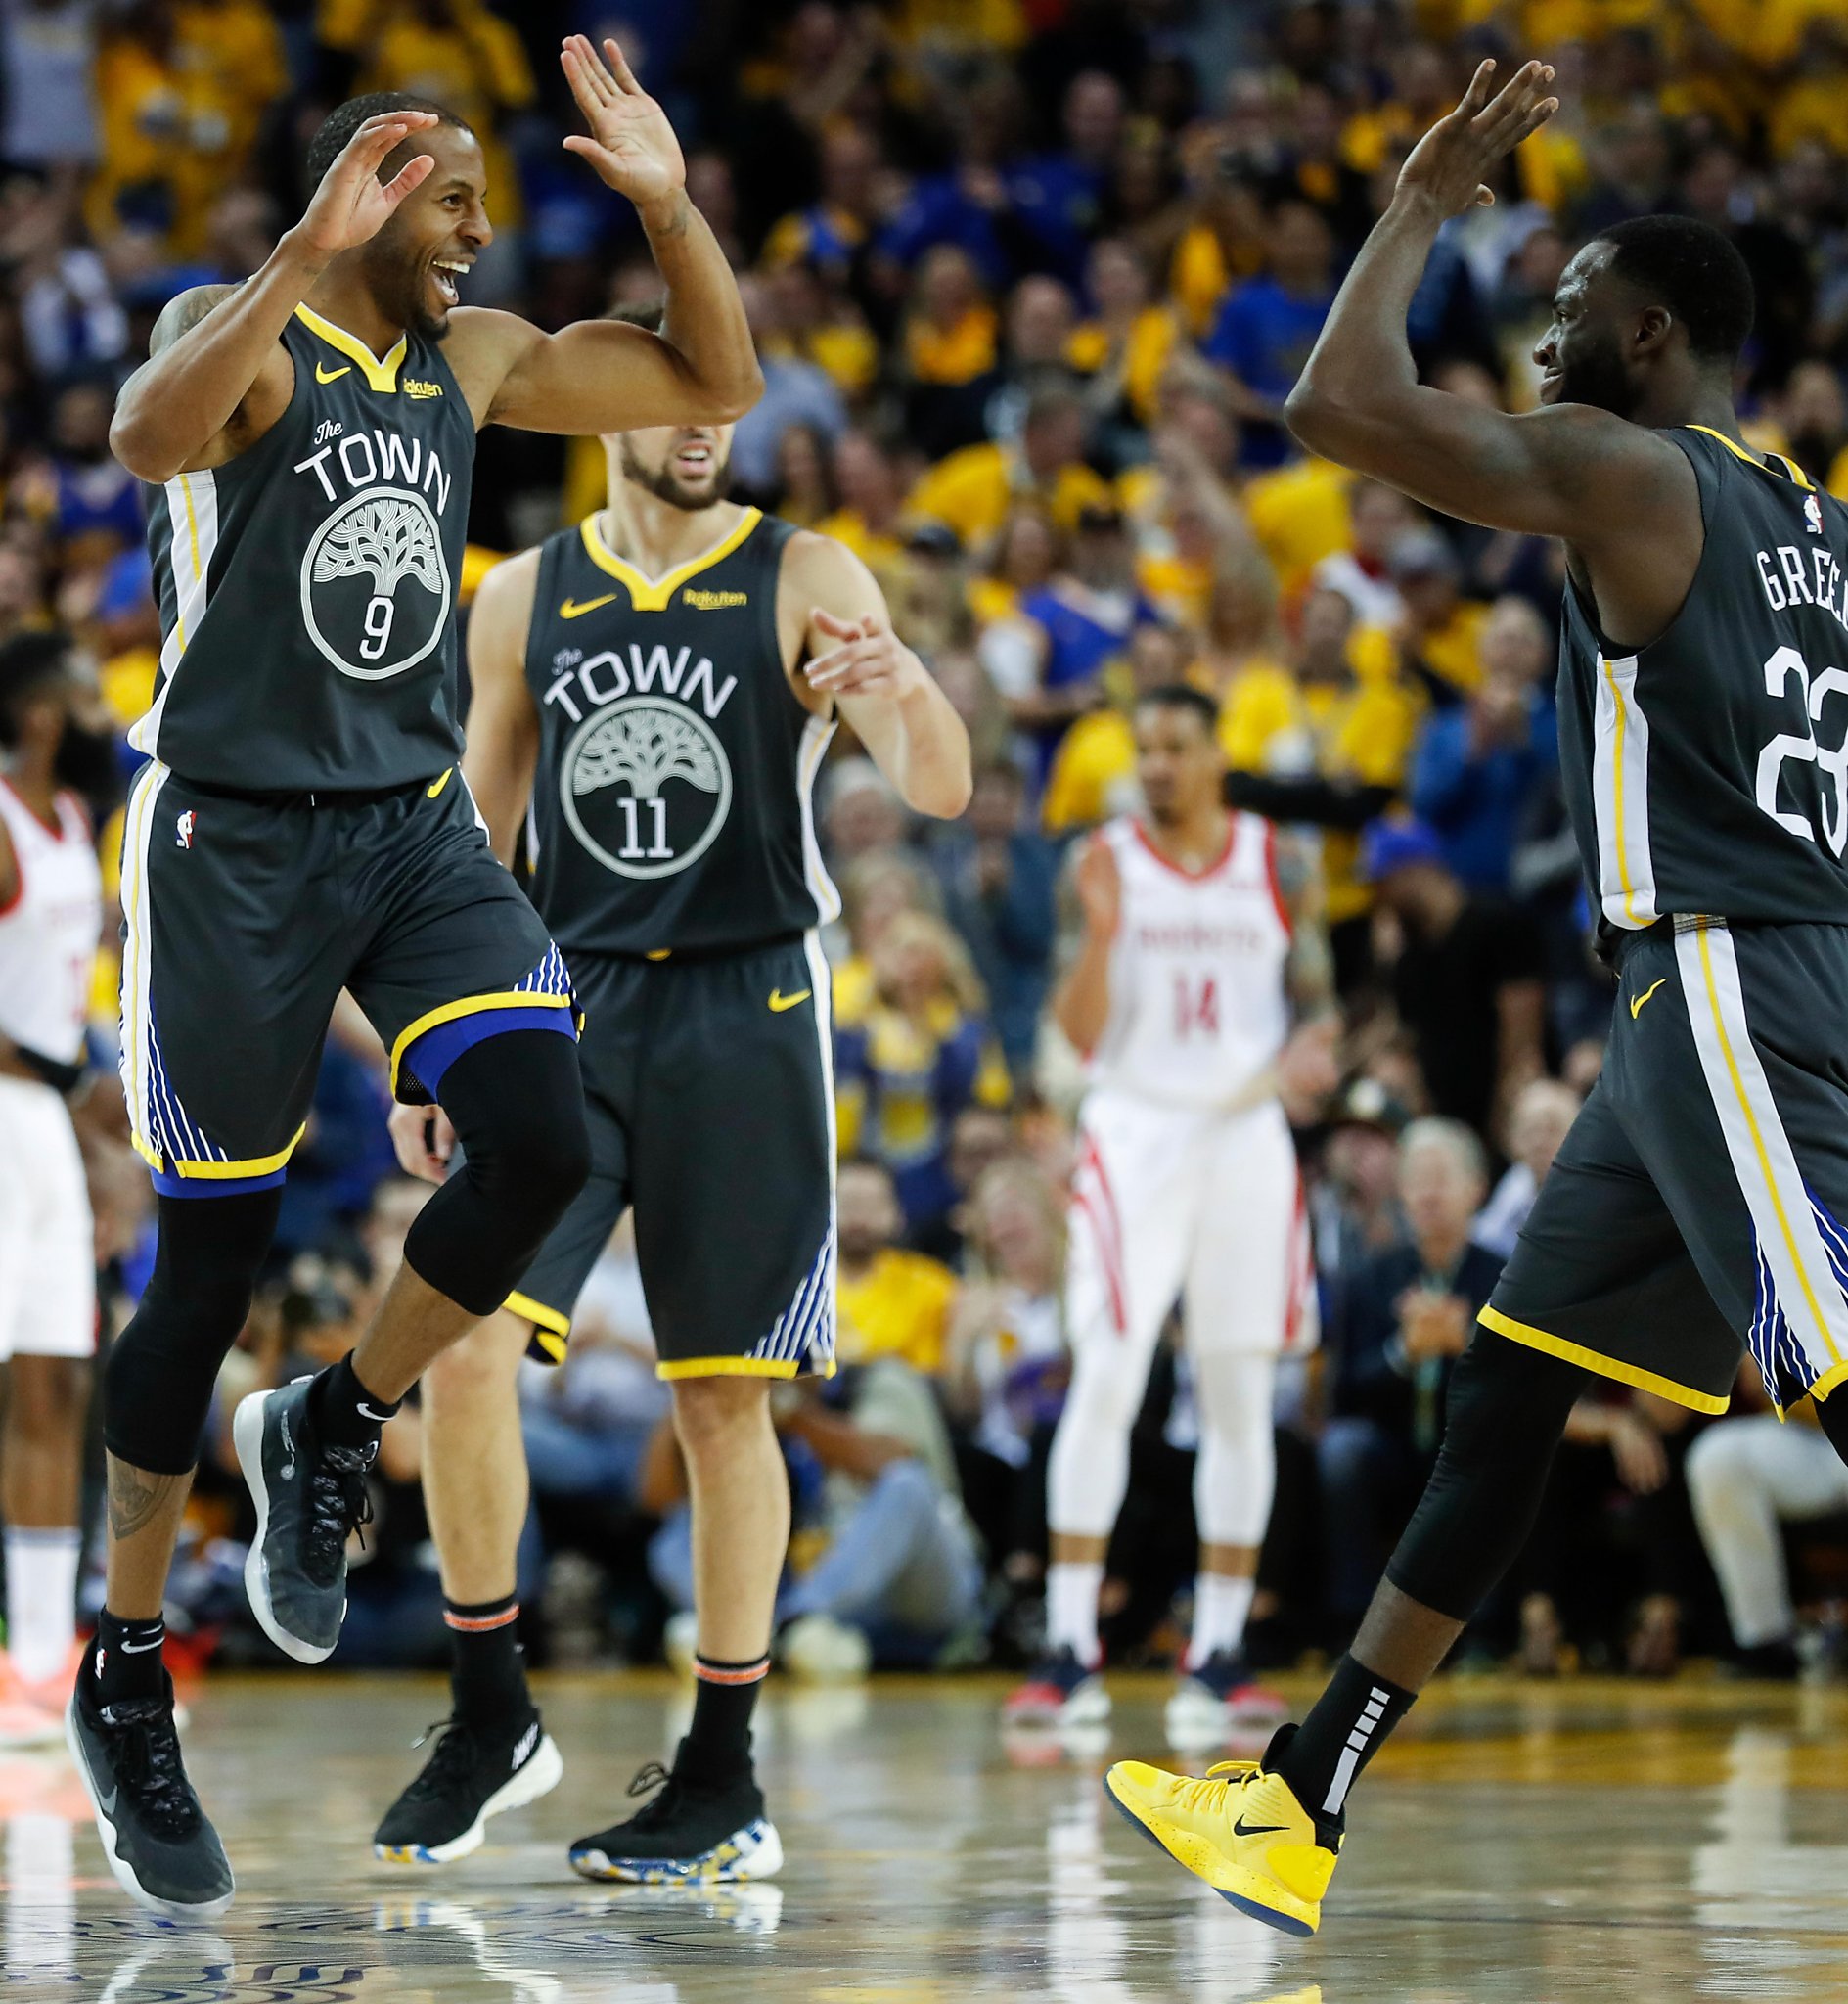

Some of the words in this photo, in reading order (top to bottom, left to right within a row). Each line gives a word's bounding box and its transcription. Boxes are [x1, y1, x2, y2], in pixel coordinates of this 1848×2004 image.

[314, 420, 343, 445] The
[293, 429, 452, 517] TOWN
[359, 597, 394, 660] 9
[543, 643, 738, 723] TOWN
[552, 647, 583, 676] The
[1756, 645, 1848, 859] 23
[616, 797, 674, 859] 11
[1174, 973, 1219, 1041] 14
